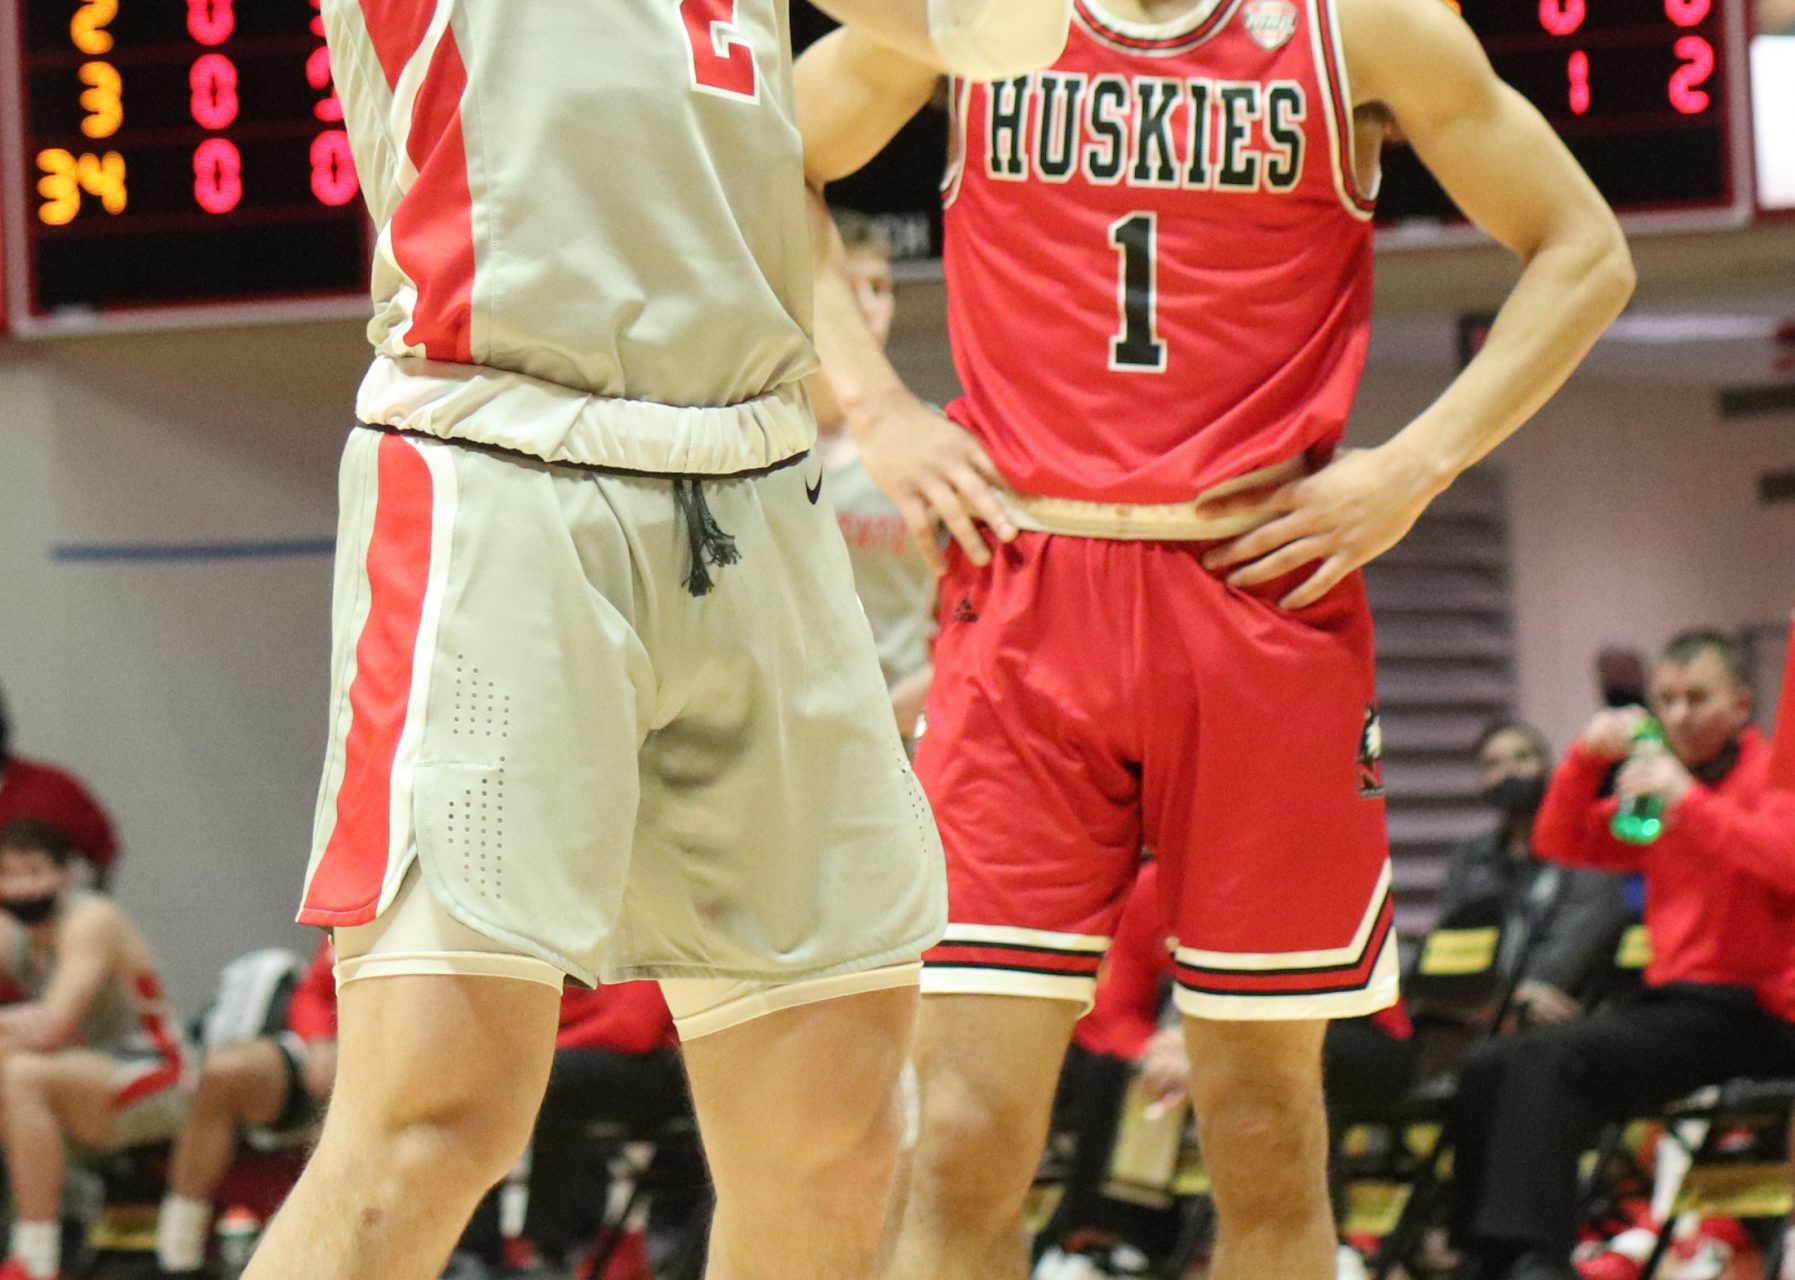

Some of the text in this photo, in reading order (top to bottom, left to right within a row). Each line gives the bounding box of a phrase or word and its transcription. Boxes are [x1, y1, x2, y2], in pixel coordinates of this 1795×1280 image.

[79, 60, 123, 139] 3
[189, 53, 239, 130] 0
[1567, 35, 1715, 116] 1 2
[36, 129, 359, 226] 34 0 0
[985, 75, 1307, 193] HUSKIES
[1106, 211, 1169, 375] 1
